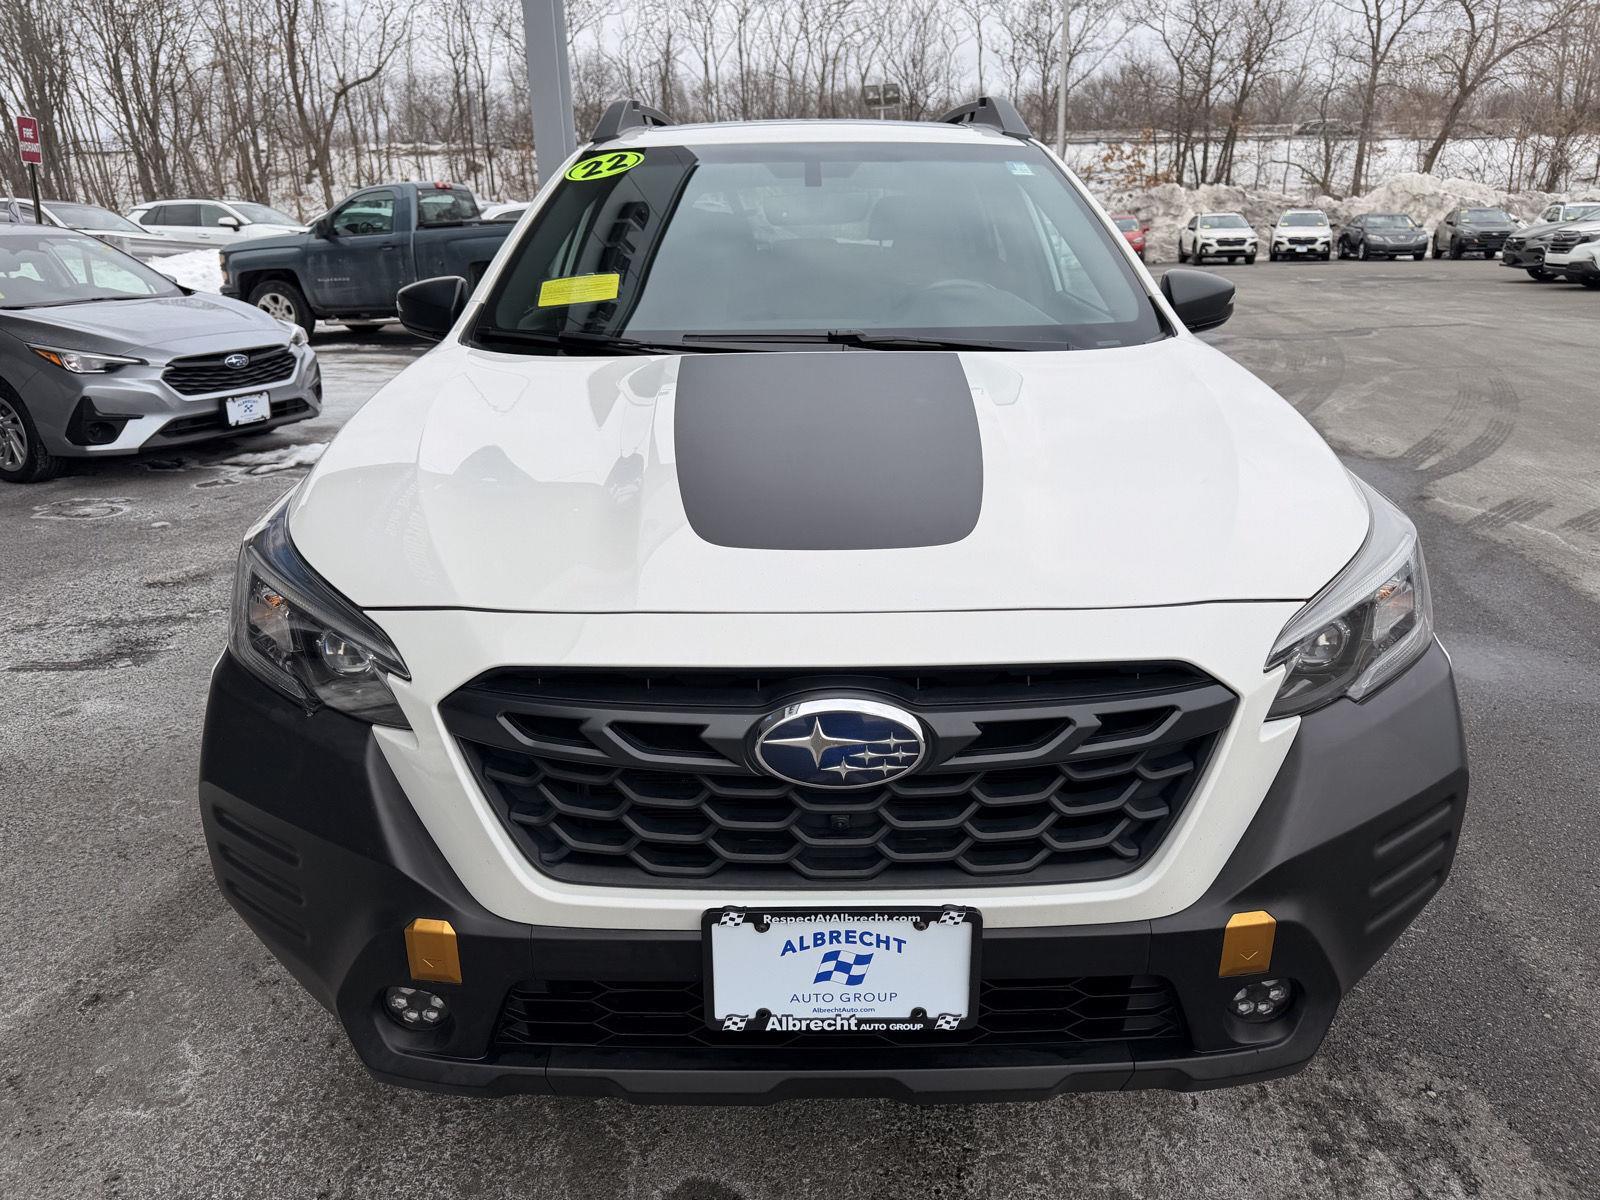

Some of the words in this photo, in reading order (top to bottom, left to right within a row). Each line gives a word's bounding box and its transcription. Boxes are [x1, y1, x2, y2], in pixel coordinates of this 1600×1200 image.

[581, 154, 629, 178] 22
[762, 913, 922, 925] RespectAtAlbrecht.com
[780, 929, 907, 957] ALBRECHT
[789, 993, 834, 1004] AUTO
[839, 992, 899, 1003] GROUP
[811, 1006, 876, 1014] AlbrechtAuto.com
[764, 1014, 859, 1032] Albrecht
[859, 1023, 888, 1032] AUTO
[889, 1023, 925, 1032] GROUP
